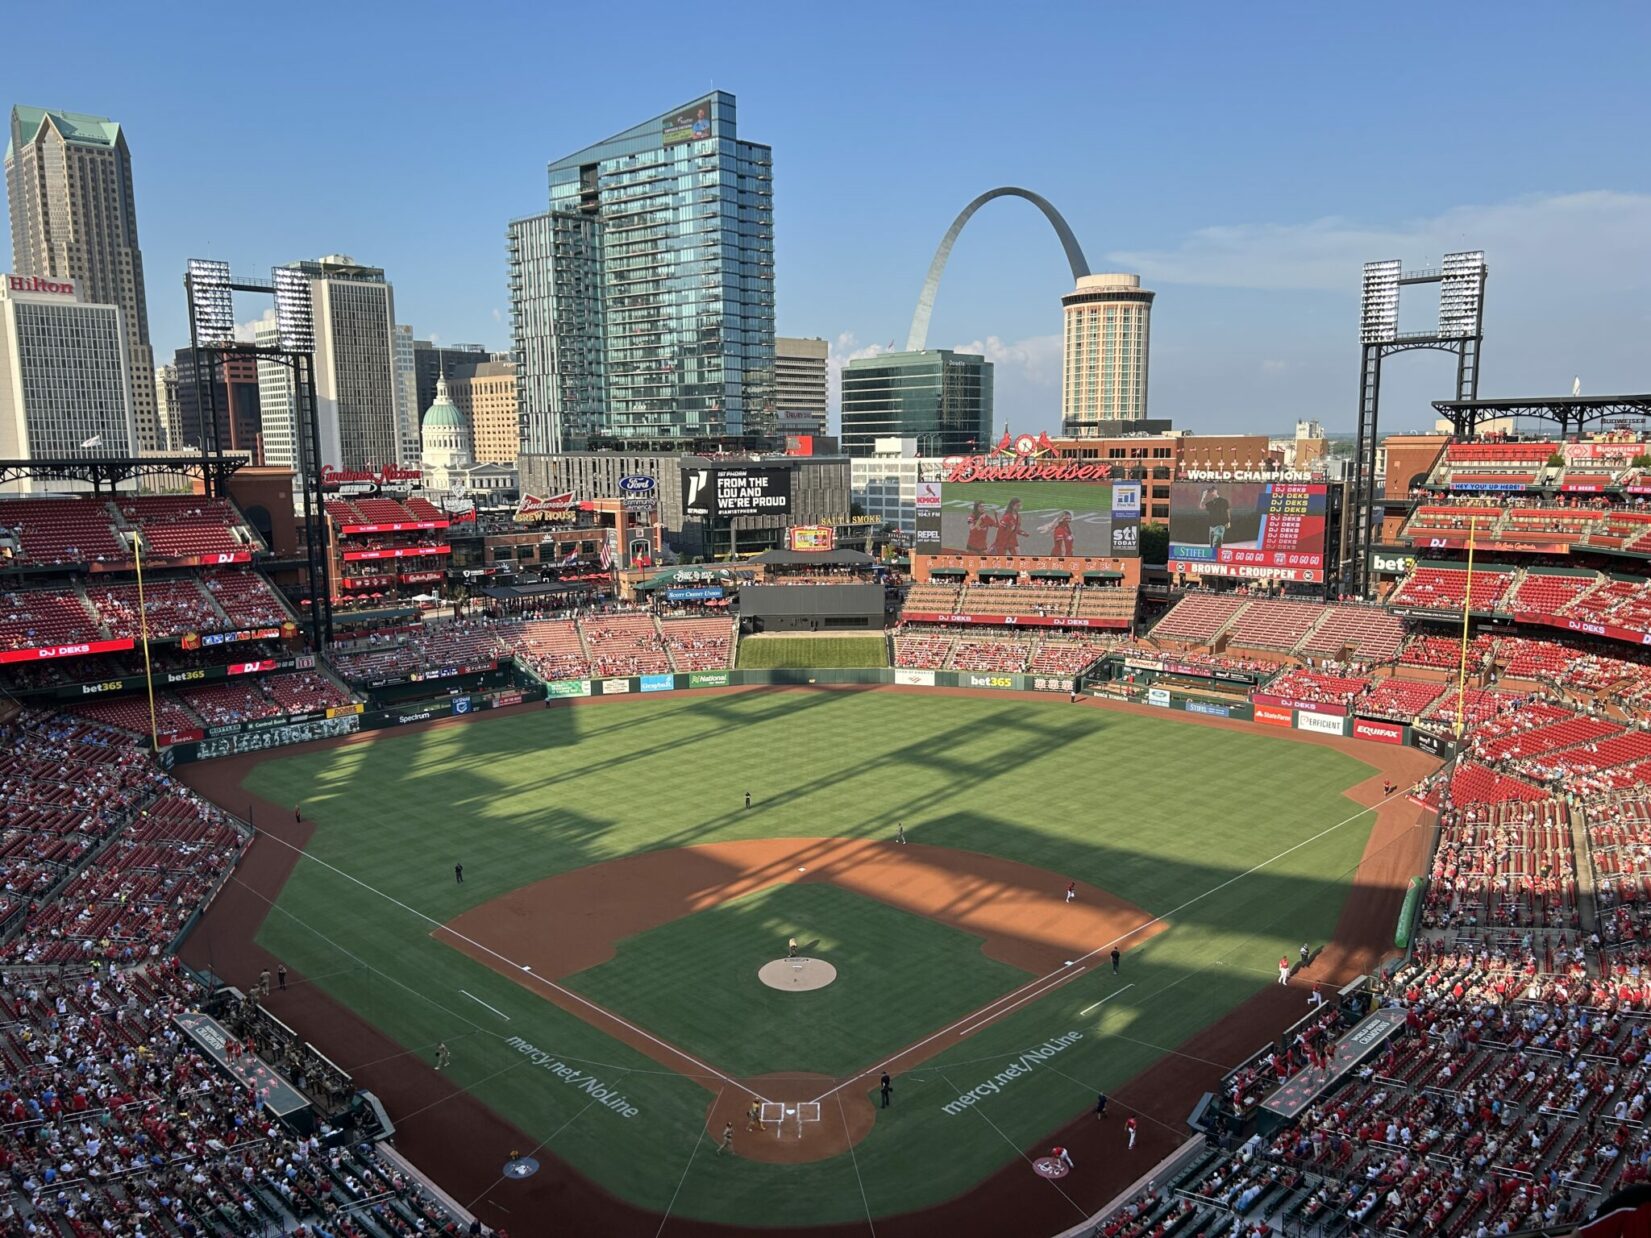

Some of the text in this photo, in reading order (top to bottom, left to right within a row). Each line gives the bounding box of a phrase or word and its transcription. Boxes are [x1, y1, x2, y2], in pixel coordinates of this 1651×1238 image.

[9, 276, 74, 294] Hilton
[374, 463, 422, 485] Nation
[943, 454, 1113, 482] Budweiser
[1187, 470, 1312, 480] WORLD CHAMPIONS
[627, 477, 650, 489] Ford
[718, 477, 768, 488] FROM THE
[718, 487, 761, 498] LOU AND
[521, 499, 573, 511] Budweiser
[718, 496, 786, 508] WE'RE PROUD
[515, 510, 577, 522] BREW HOUSE
[821, 517, 844, 526] SALT
[852, 514, 881, 524] SMOKE
[1113, 526, 1137, 540] stl
[1430, 538, 1447, 548] DJ
[218, 553, 234, 563] DJ
[1180, 548, 1207, 558] STIFEL
[1245, 553, 1254, 561] GO
[1255, 553, 1264, 562] GO
[1289, 556, 1298, 564] GO
[1299, 556, 1308, 564] GO
[1310, 556, 1319, 565] GO
[1192, 563, 1296, 579] BROWN & CROUPPEN
[1005, 616, 1018, 624] DJ
[1568, 620, 1605, 634] DJ DEKS
[39, 645, 90, 658] DJ DEKS
[244, 662, 260, 672] DJ
[168, 670, 205, 682] bet365
[700, 674, 727, 683] National
[970, 675, 1012, 687] bet365
[82, 681, 123, 694] bet365
[1294, 701, 1316, 710] DEKS
[400, 712, 430, 724] Spectrum
[1357, 726, 1399, 738] EQUIFAX
[505, 1036, 640, 1118] mercy.net/NoLine
[941, 1030, 1084, 1116] mercy.net/NoLine
